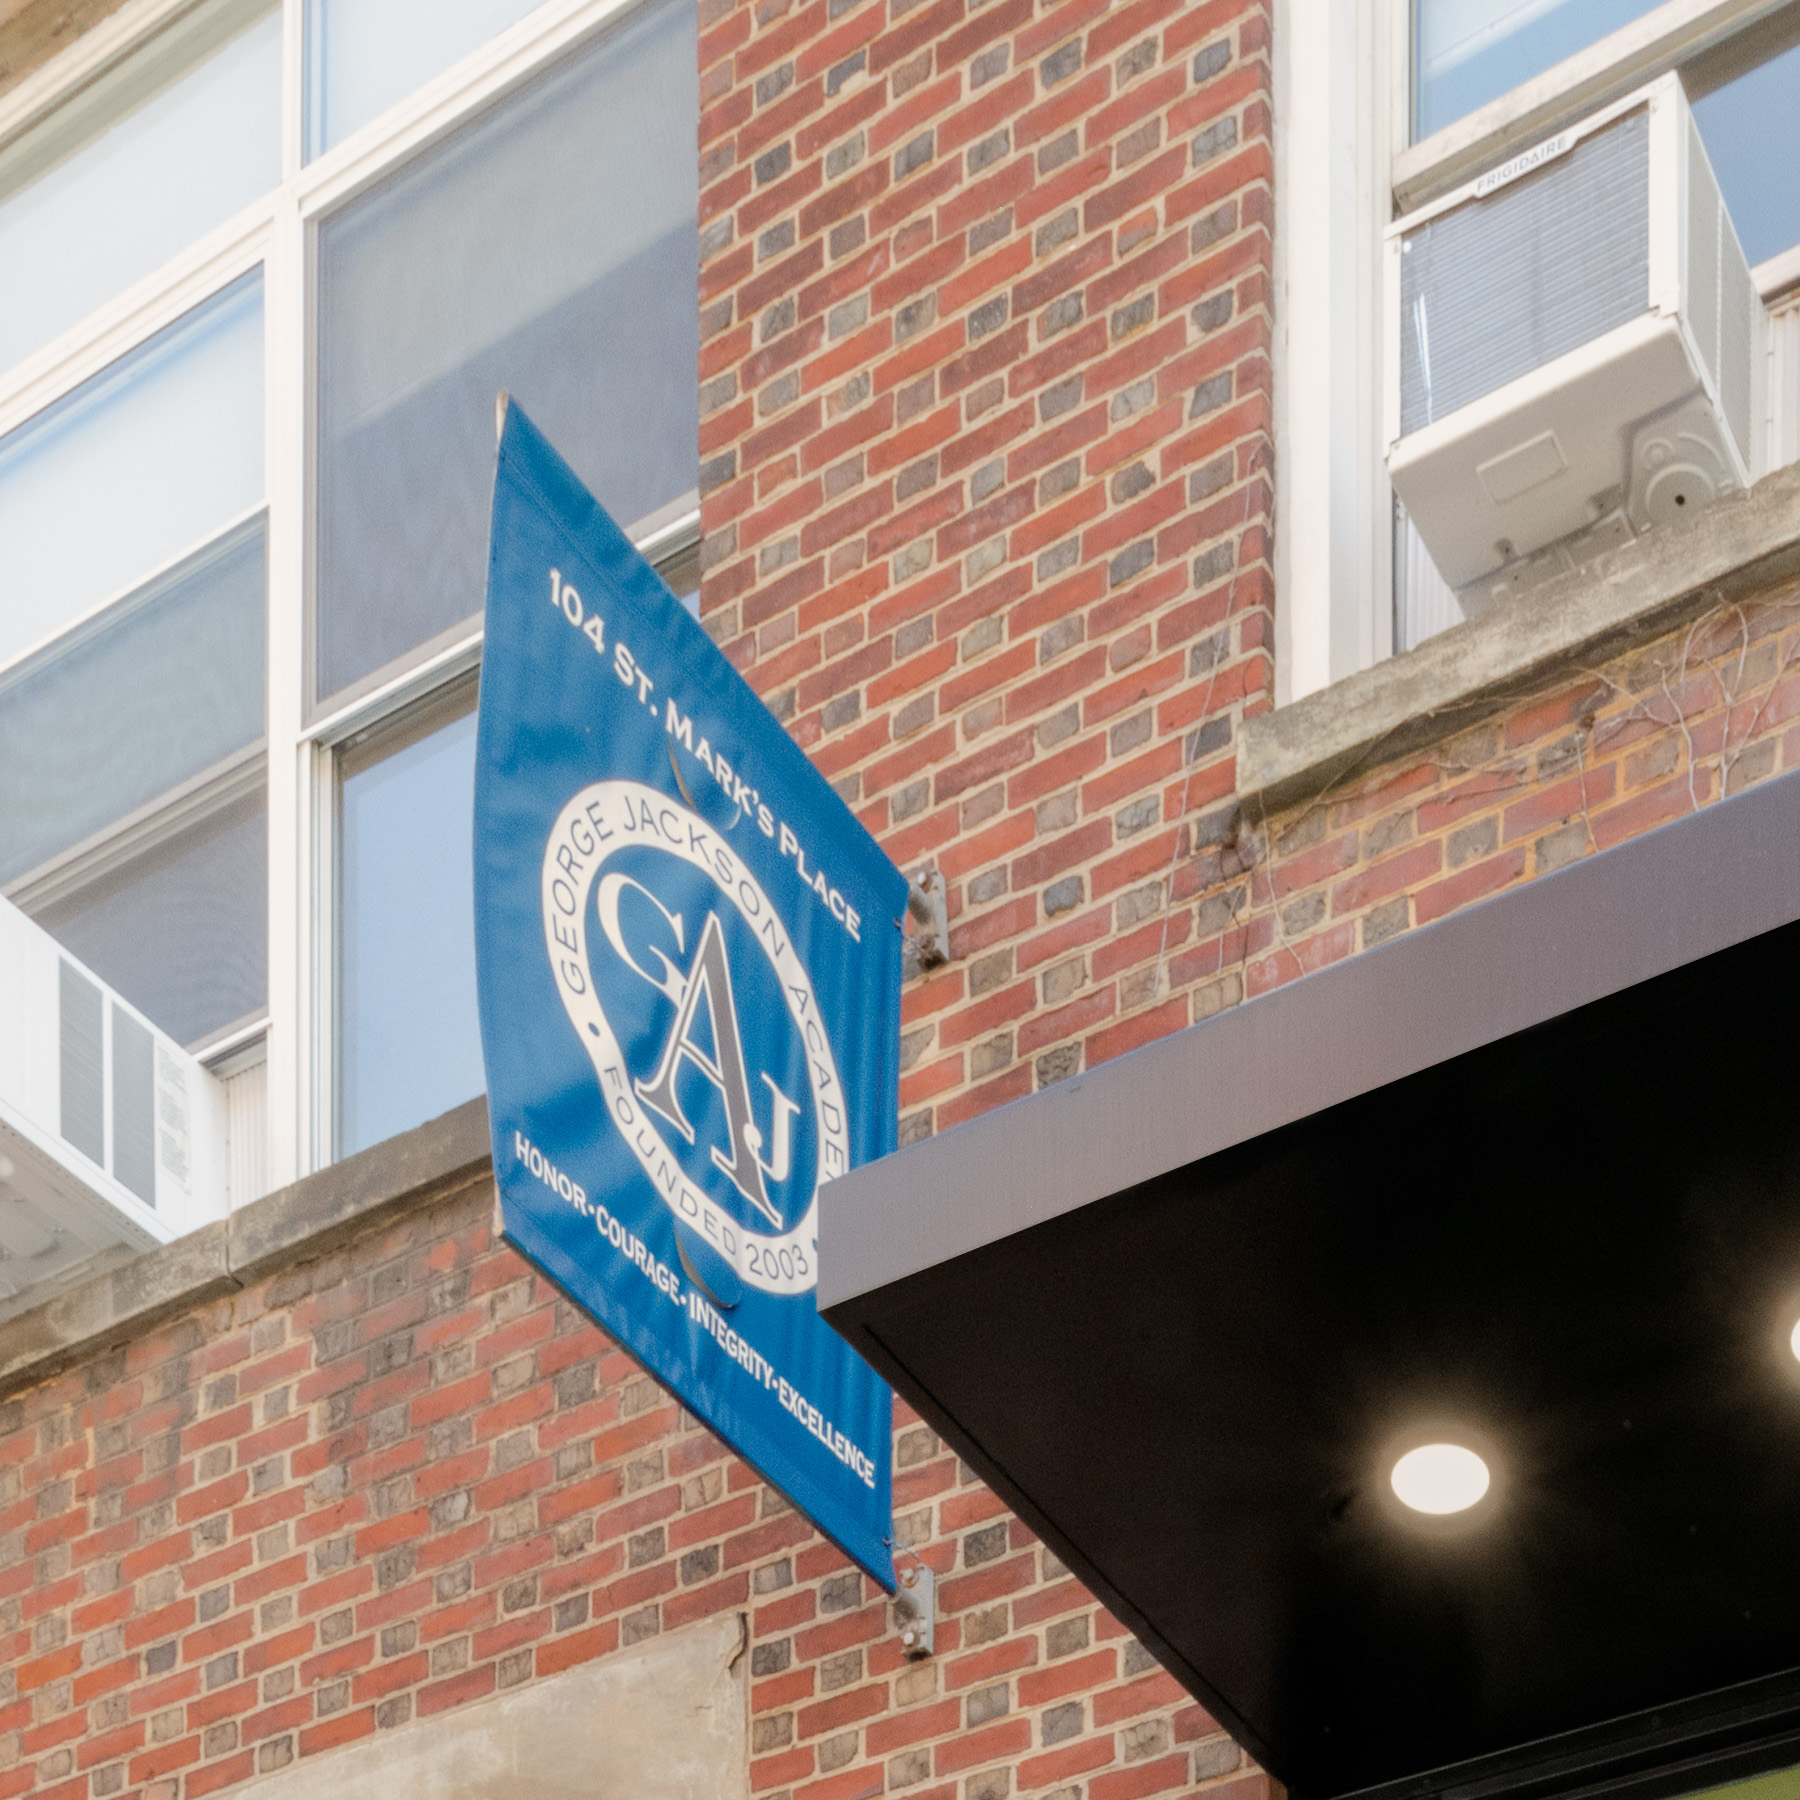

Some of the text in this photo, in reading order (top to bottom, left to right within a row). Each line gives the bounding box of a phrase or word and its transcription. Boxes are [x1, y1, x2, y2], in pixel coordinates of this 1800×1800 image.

[1477, 136, 1567, 193] FRIGIDAIRE
[551, 567, 861, 943] 104 ST. MARK'S PLACE
[552, 796, 845, 1181] GEORGE JACKSON ACADE
[604, 1066, 809, 1280] FOUNDED 2003
